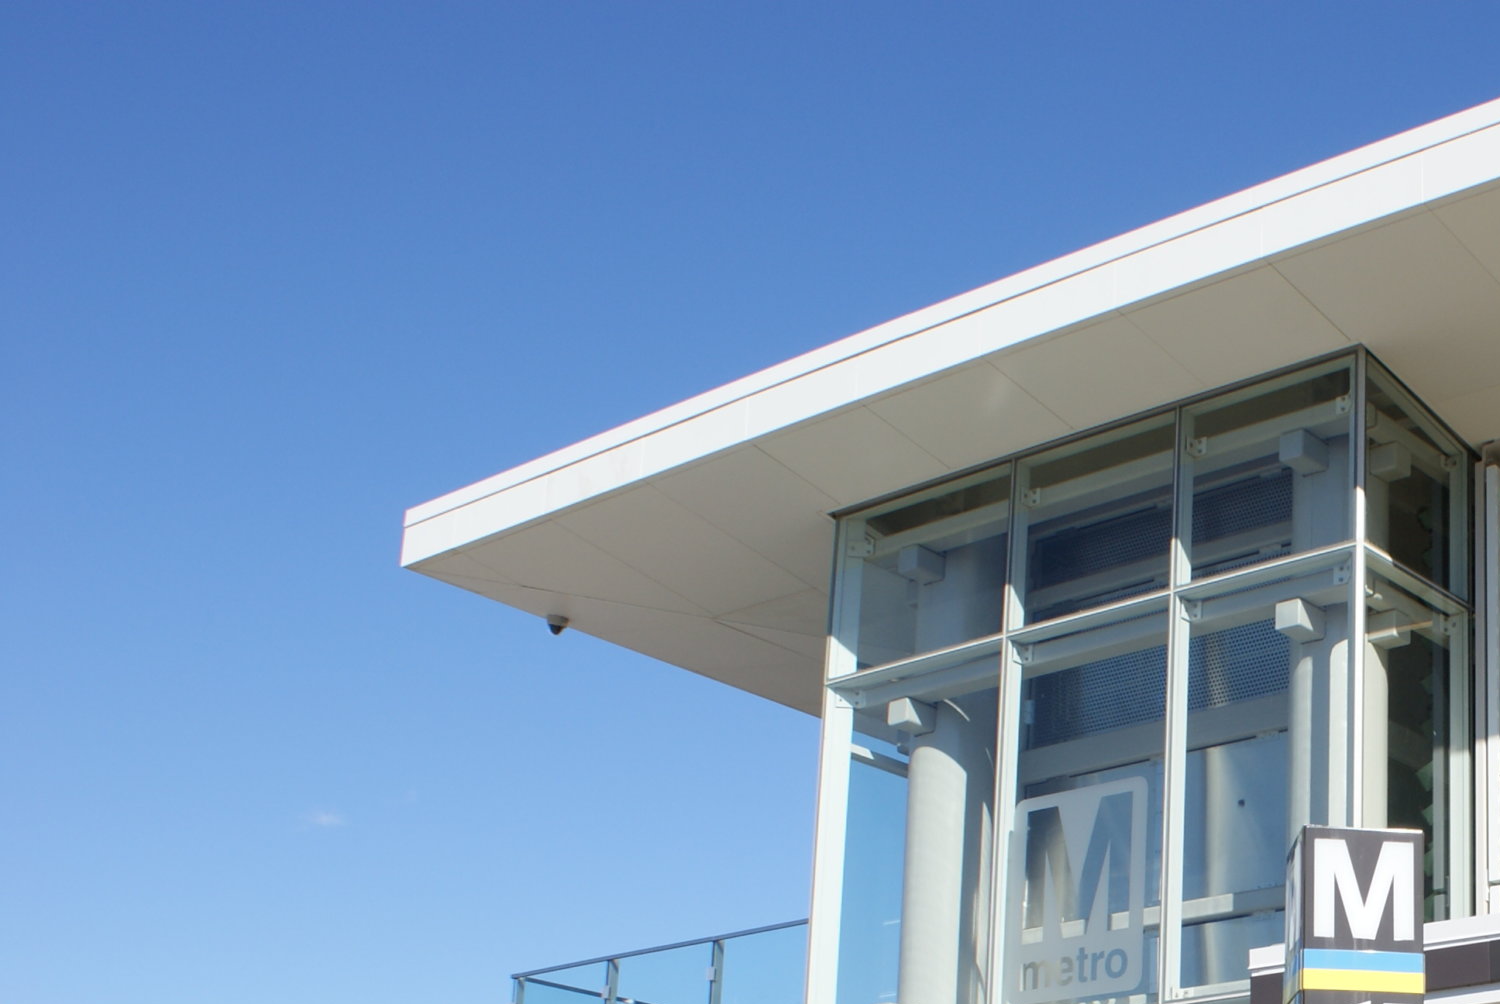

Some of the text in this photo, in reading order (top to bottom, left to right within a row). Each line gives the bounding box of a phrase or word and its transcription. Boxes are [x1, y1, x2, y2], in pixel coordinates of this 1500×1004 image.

[1021, 791, 1134, 945] M
[1313, 838, 1415, 942] M
[1020, 947, 1128, 993] metro
